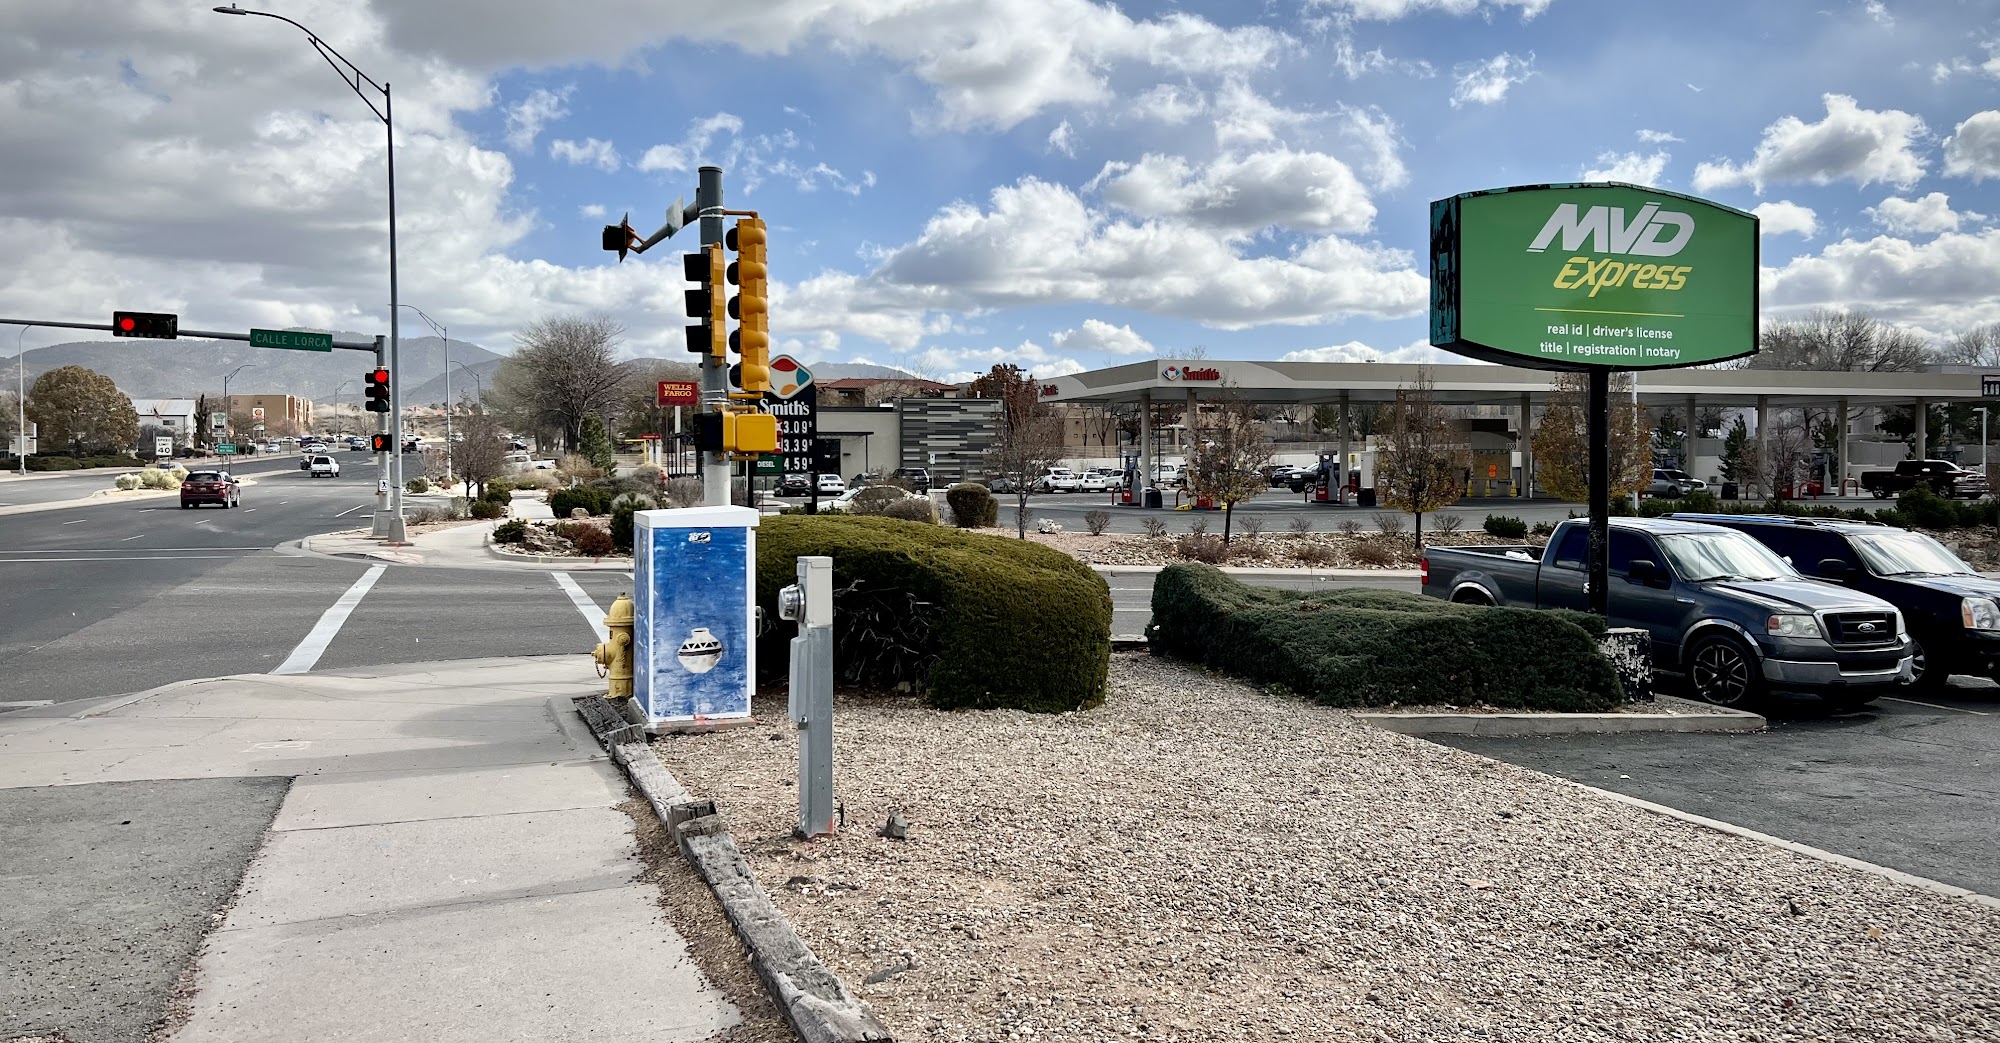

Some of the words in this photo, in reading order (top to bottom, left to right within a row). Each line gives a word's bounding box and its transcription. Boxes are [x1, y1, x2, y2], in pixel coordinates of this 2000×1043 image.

[1526, 201, 1695, 257] MVD
[1547, 323, 1568, 335] real
[1571, 324, 1583, 336] id
[1592, 325, 1634, 338] driver's
[1636, 327, 1673, 339] license
[255, 333, 288, 345] CALLE
[294, 336, 328, 348] LORCA
[1540, 341, 1563, 353] title
[1573, 343, 1637, 356] registration
[1646, 346, 1680, 360] notary
[663, 383, 692, 391] WELLS
[759, 398, 810, 416] Smith's
[757, 460, 775, 468] DIESEL
